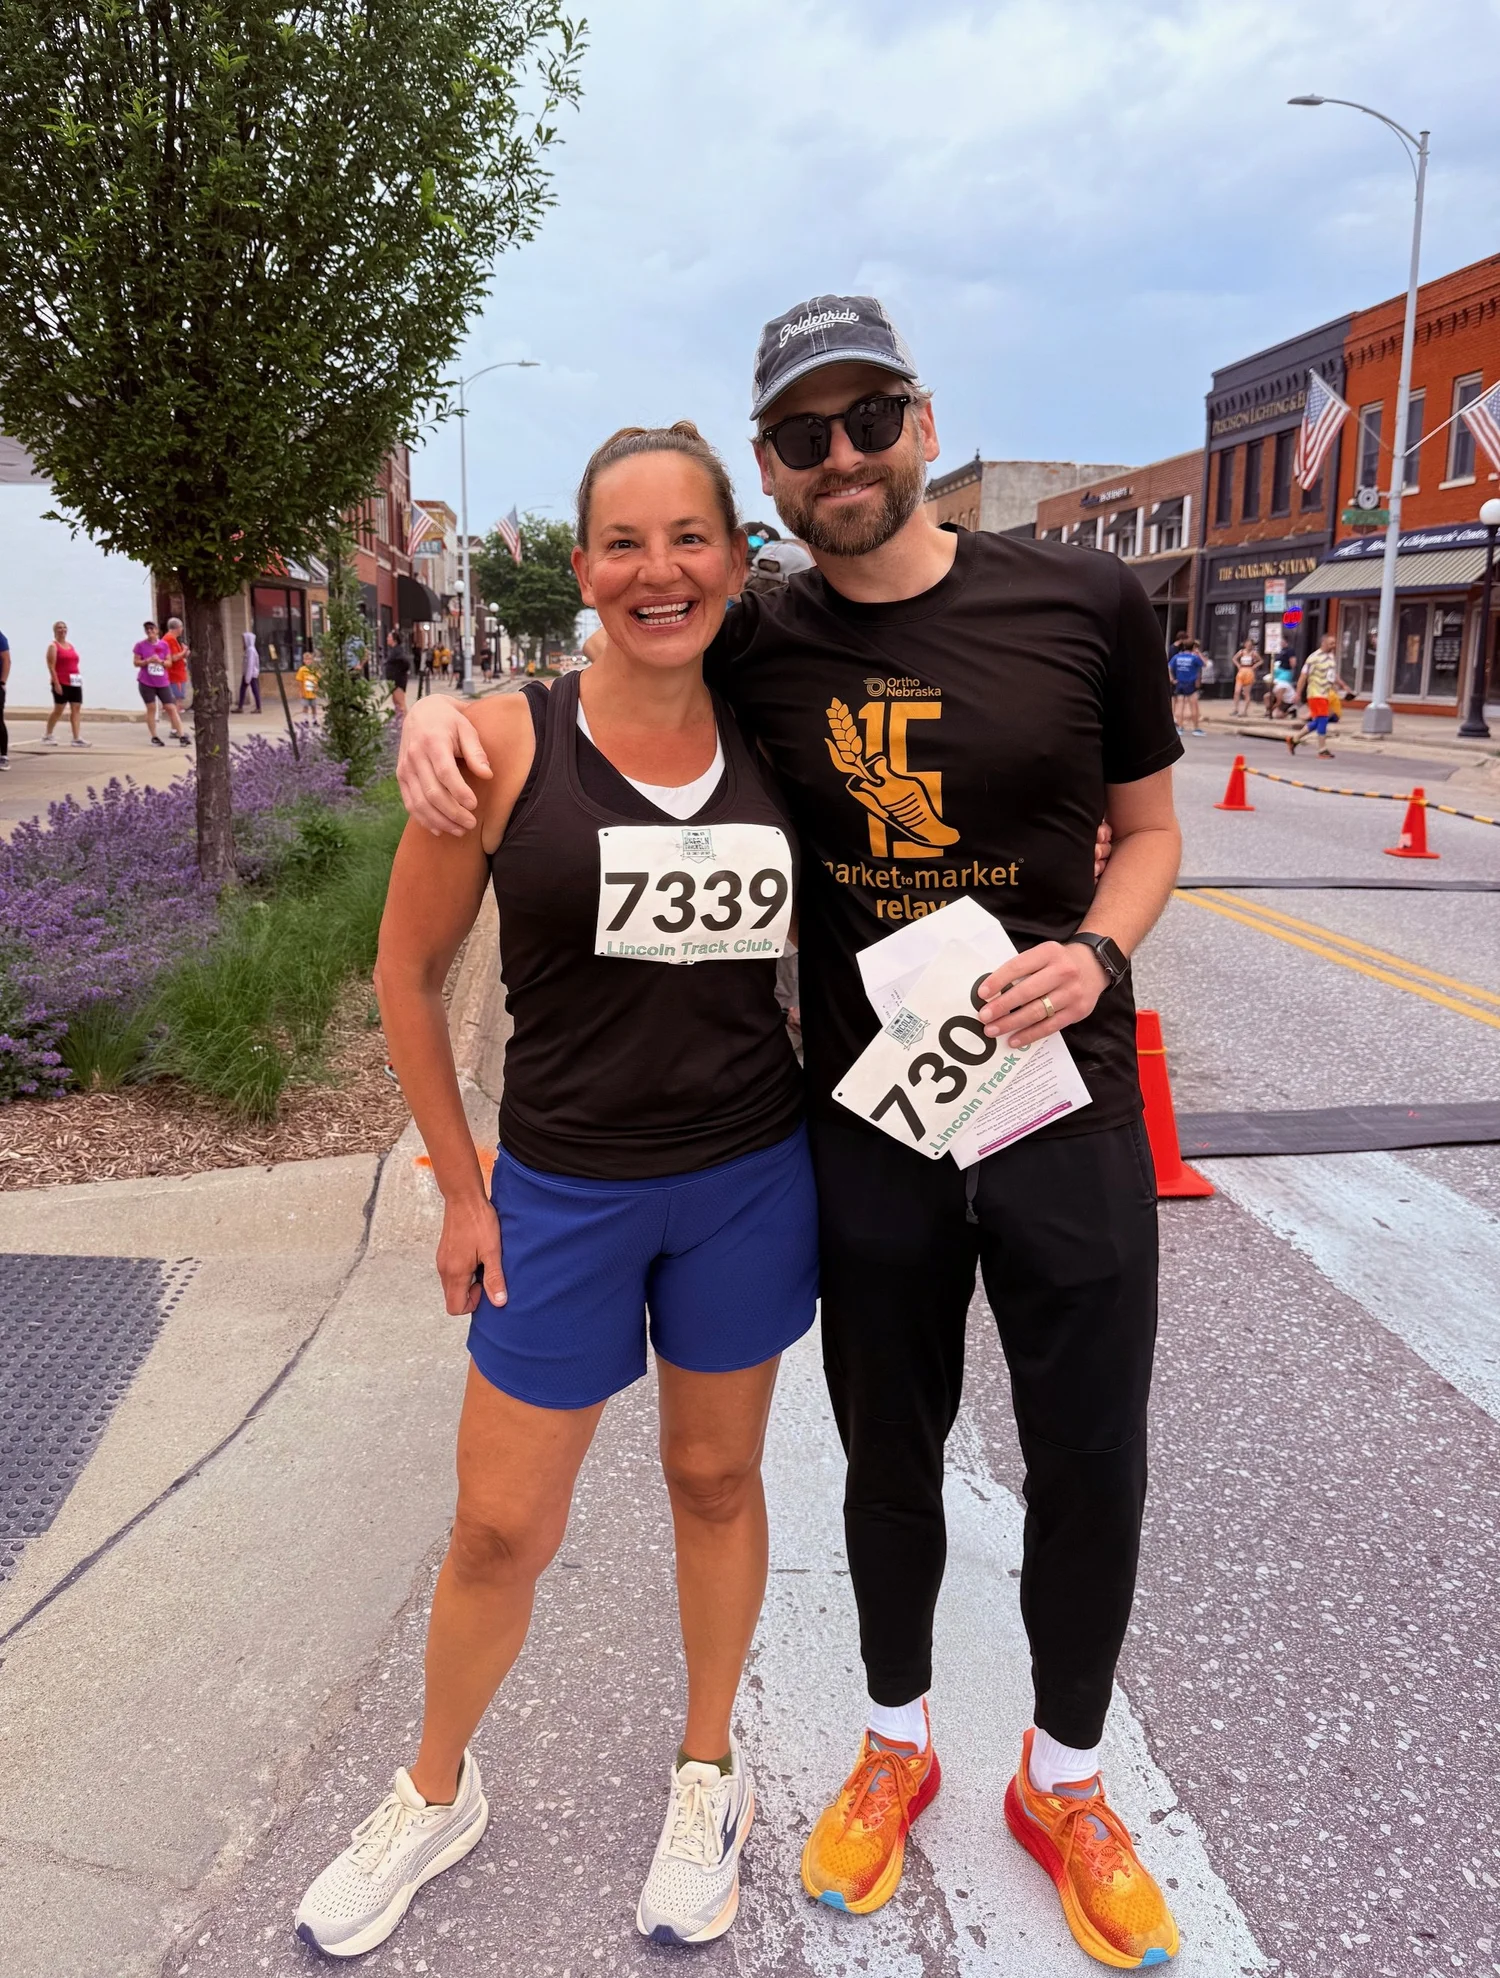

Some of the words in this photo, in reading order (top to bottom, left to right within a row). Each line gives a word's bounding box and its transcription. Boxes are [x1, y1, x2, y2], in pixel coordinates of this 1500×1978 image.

[1278, 557, 1317, 575] STATION
[886, 686, 942, 697] Nebraska
[887, 677, 920, 687] Ortho
[901, 875, 913, 885] to
[914, 861, 1019, 889] market
[605, 868, 788, 934] 7339
[606, 941, 676, 956] Lincoln
[681, 940, 728, 956] Track
[733, 938, 773, 952] Club
[869, 972, 1021, 1142] 730
[929, 1098, 983, 1151] Lincoln
[977, 1053, 1021, 1095] Track
